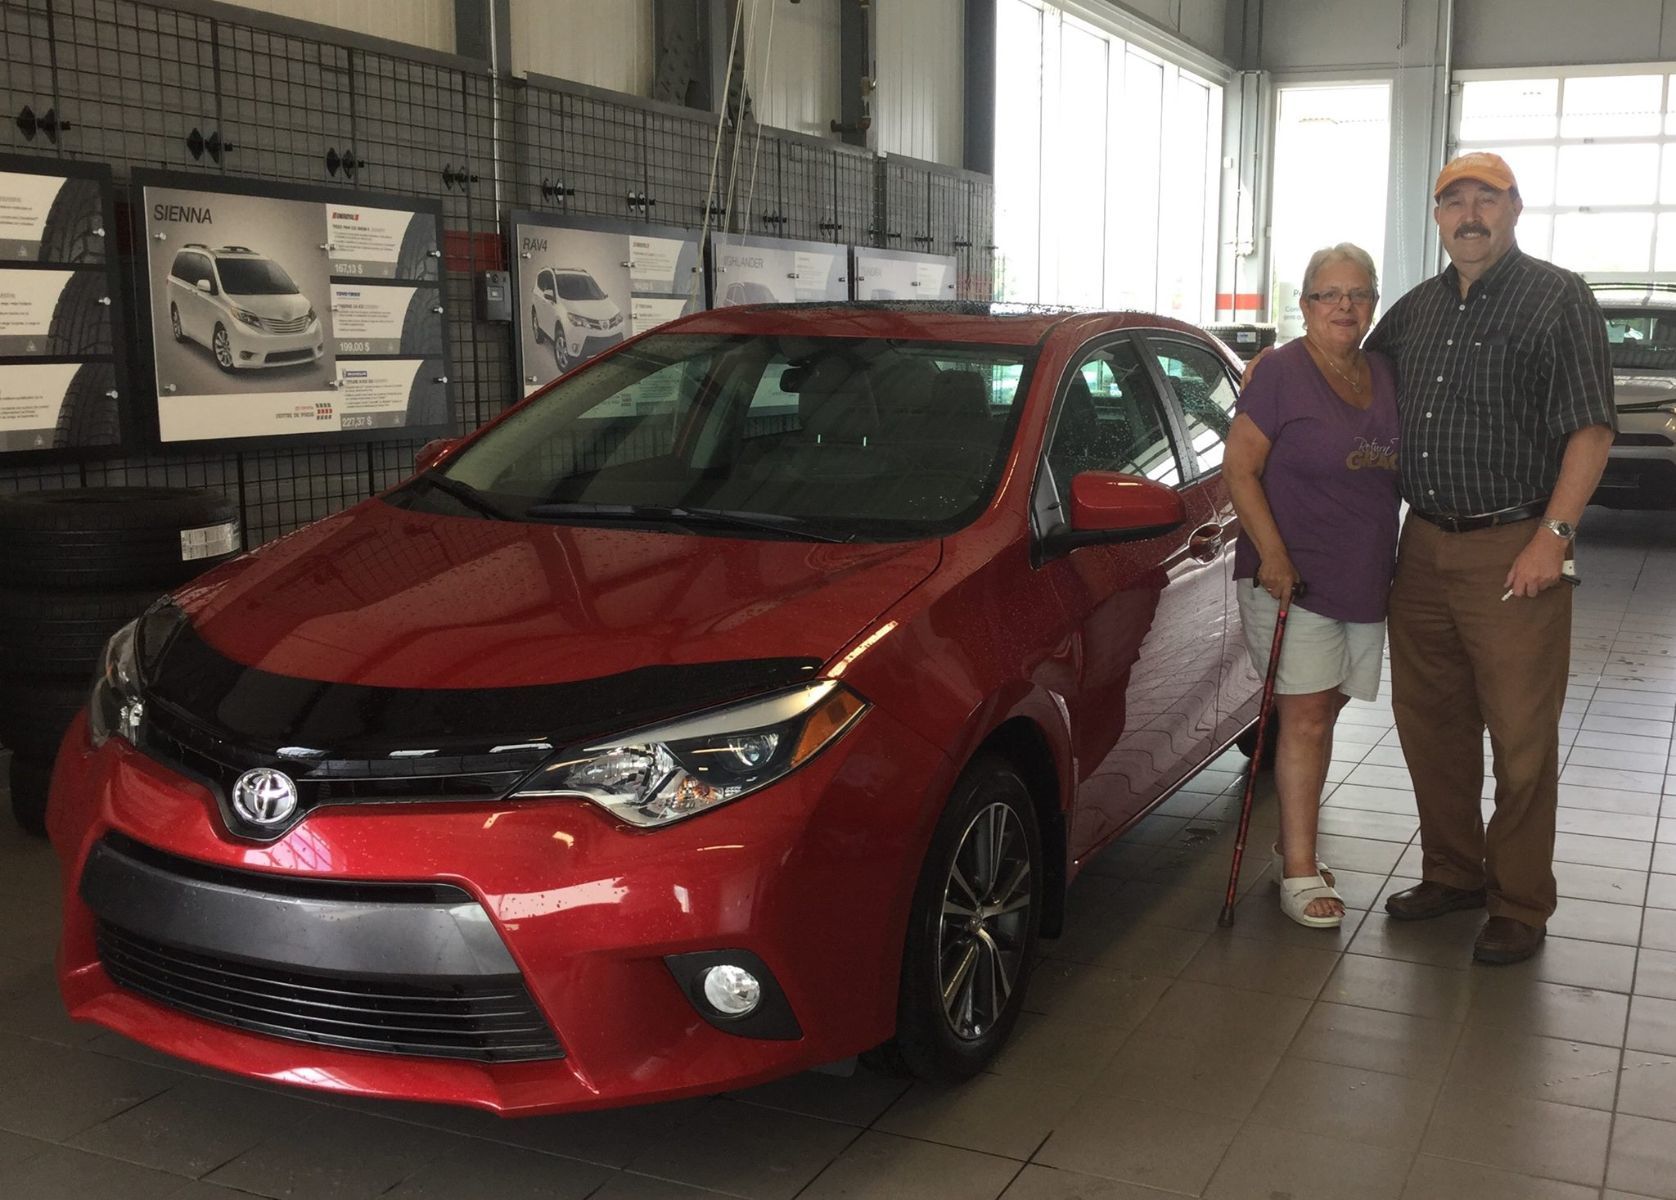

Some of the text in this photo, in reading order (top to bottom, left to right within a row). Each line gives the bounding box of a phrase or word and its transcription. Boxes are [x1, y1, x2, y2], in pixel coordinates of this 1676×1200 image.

[154, 204, 213, 224] SIENNA
[523, 237, 548, 252] RAV4
[340, 342, 363, 352] 199,00
